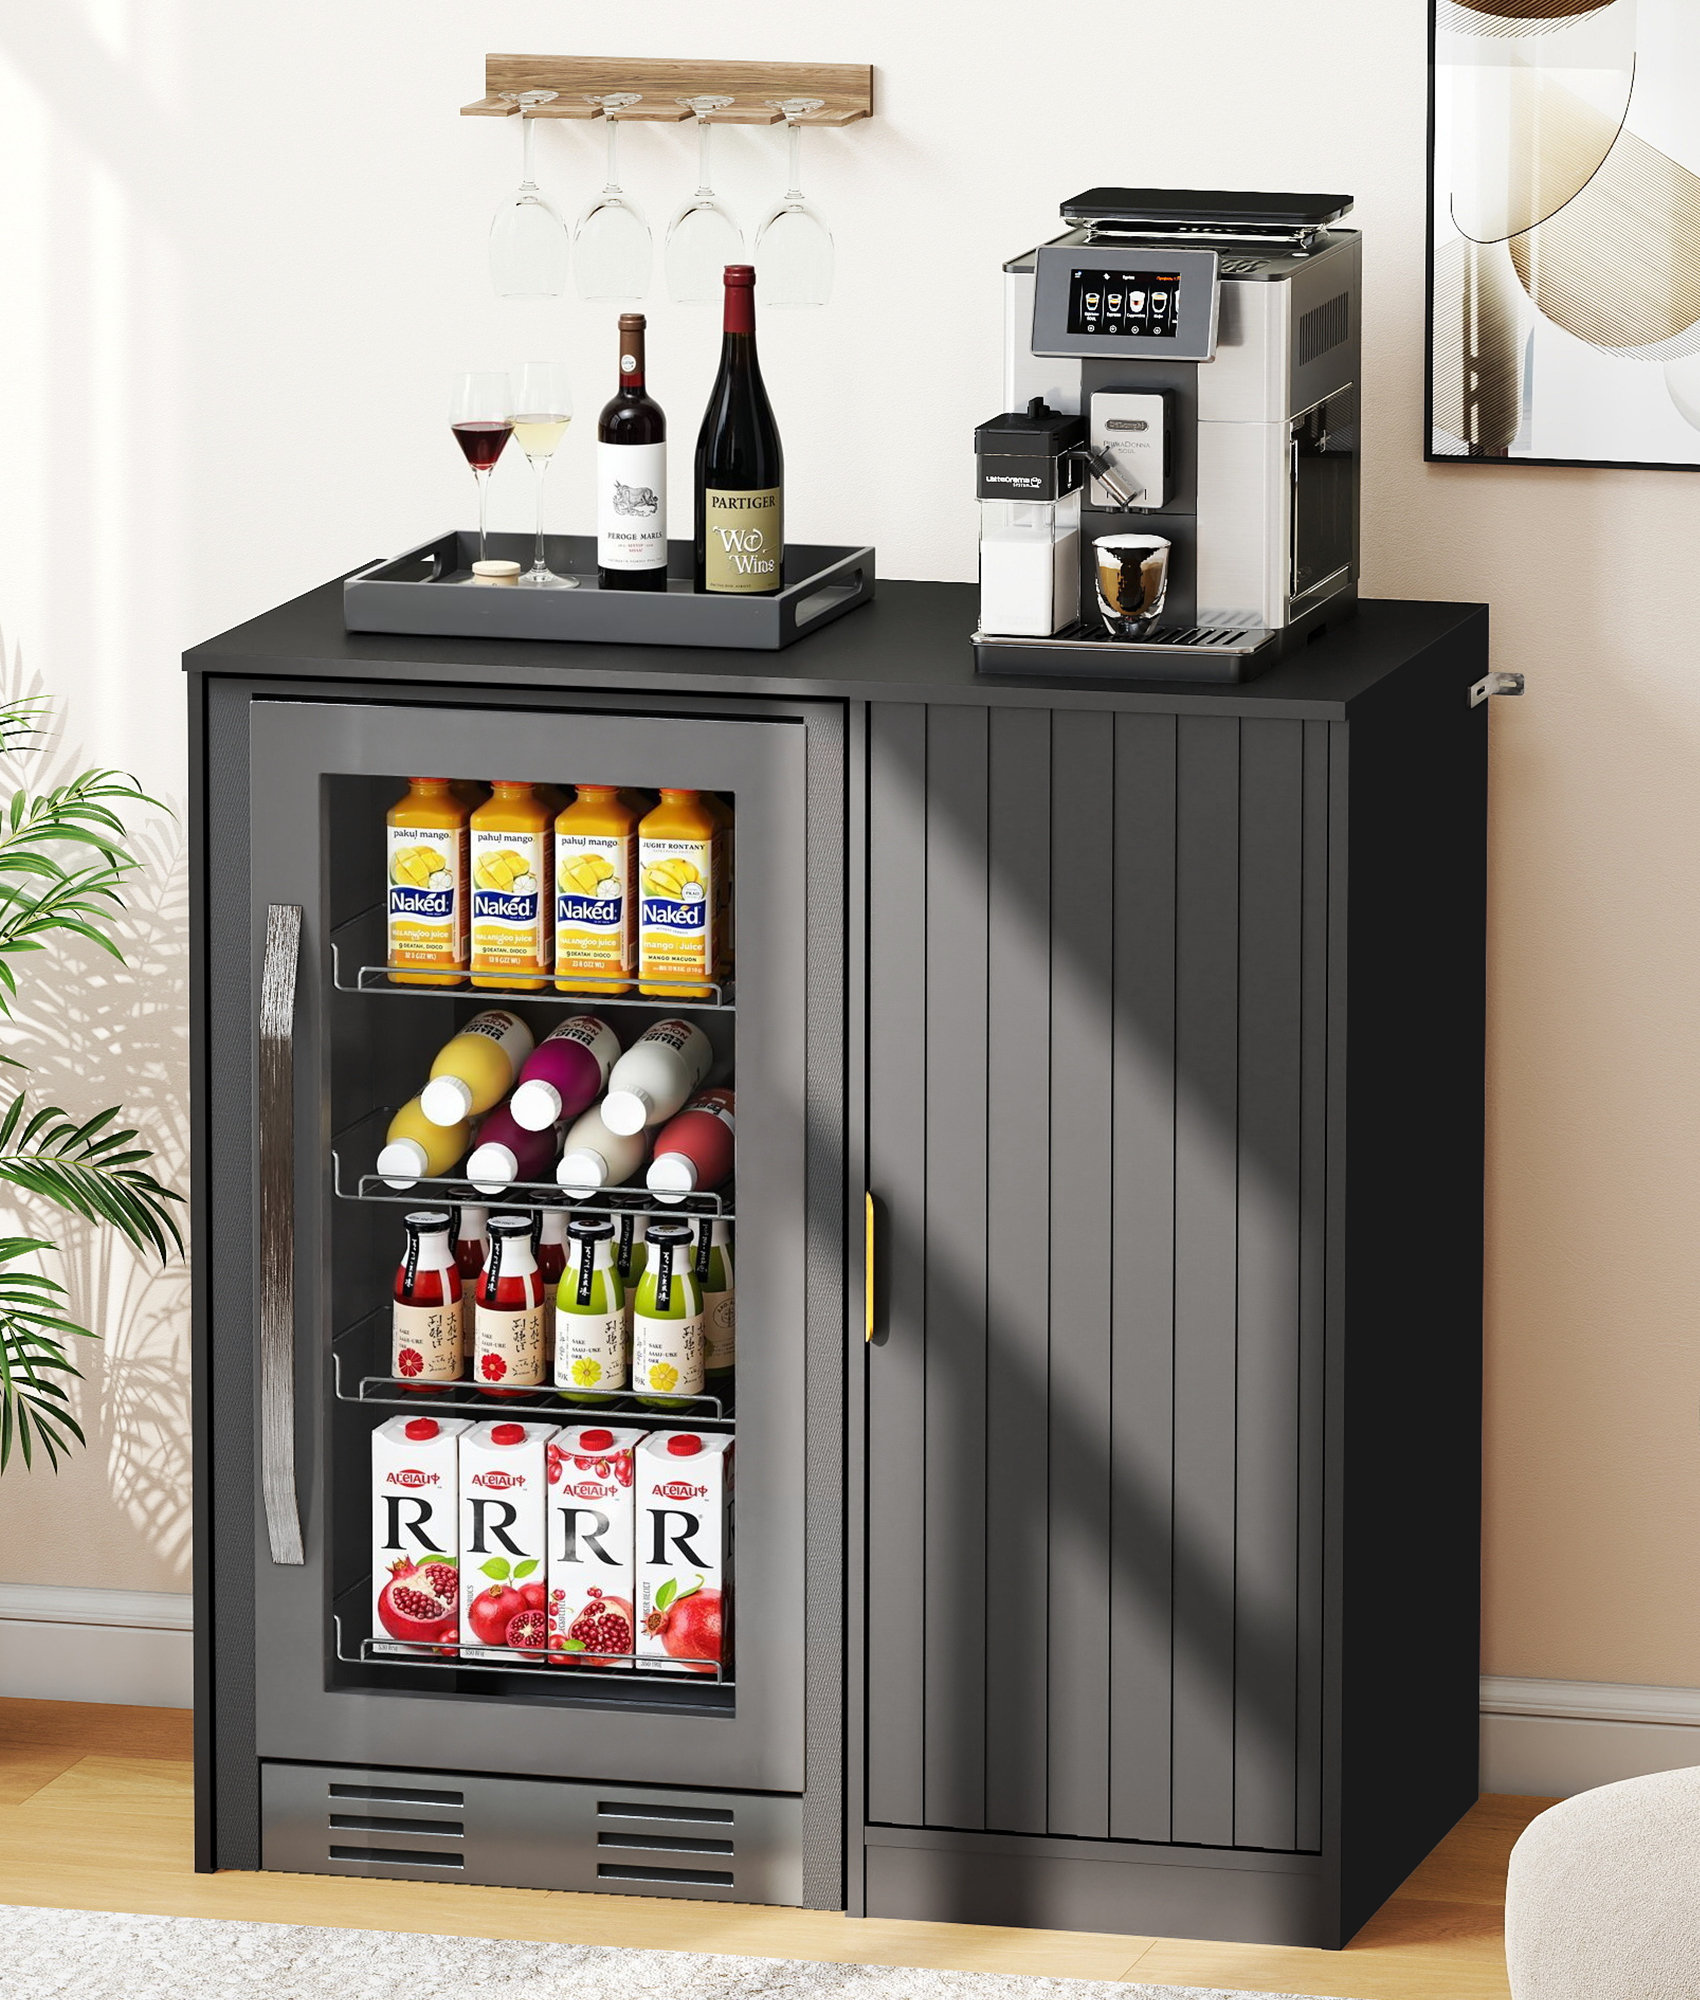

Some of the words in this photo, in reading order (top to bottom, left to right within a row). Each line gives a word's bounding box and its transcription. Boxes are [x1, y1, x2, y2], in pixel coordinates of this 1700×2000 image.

[711, 496, 776, 509] PARTIGER
[380, 1495, 447, 1553] R
[466, 1498, 531, 1557] R
[557, 1507, 624, 1566] R
[645, 1508, 714, 1569] R
